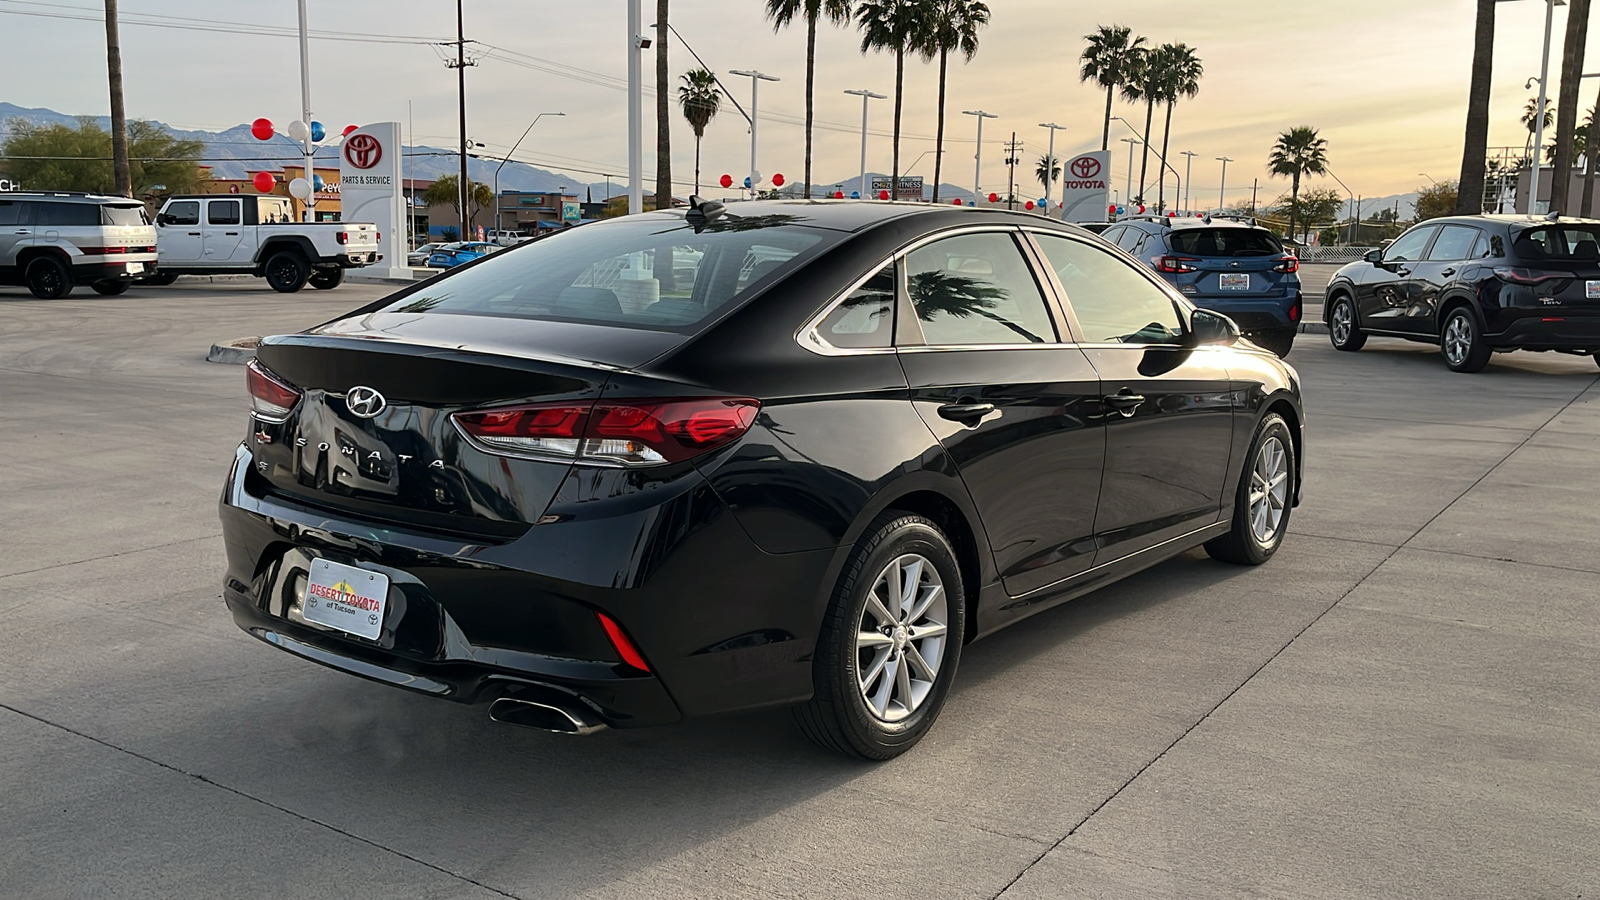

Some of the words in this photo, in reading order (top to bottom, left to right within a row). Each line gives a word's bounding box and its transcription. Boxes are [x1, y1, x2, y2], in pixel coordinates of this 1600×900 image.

[342, 176, 358, 184] PARTS
[360, 176, 365, 184] &
[365, 176, 391, 184] SERVICE
[1065, 180, 1105, 189] TOYOTA
[296, 437, 445, 470] SONATA
[310, 583, 342, 602] DESERT
[345, 592, 380, 612] TOYOTA
[334, 603, 356, 615] Tucson
